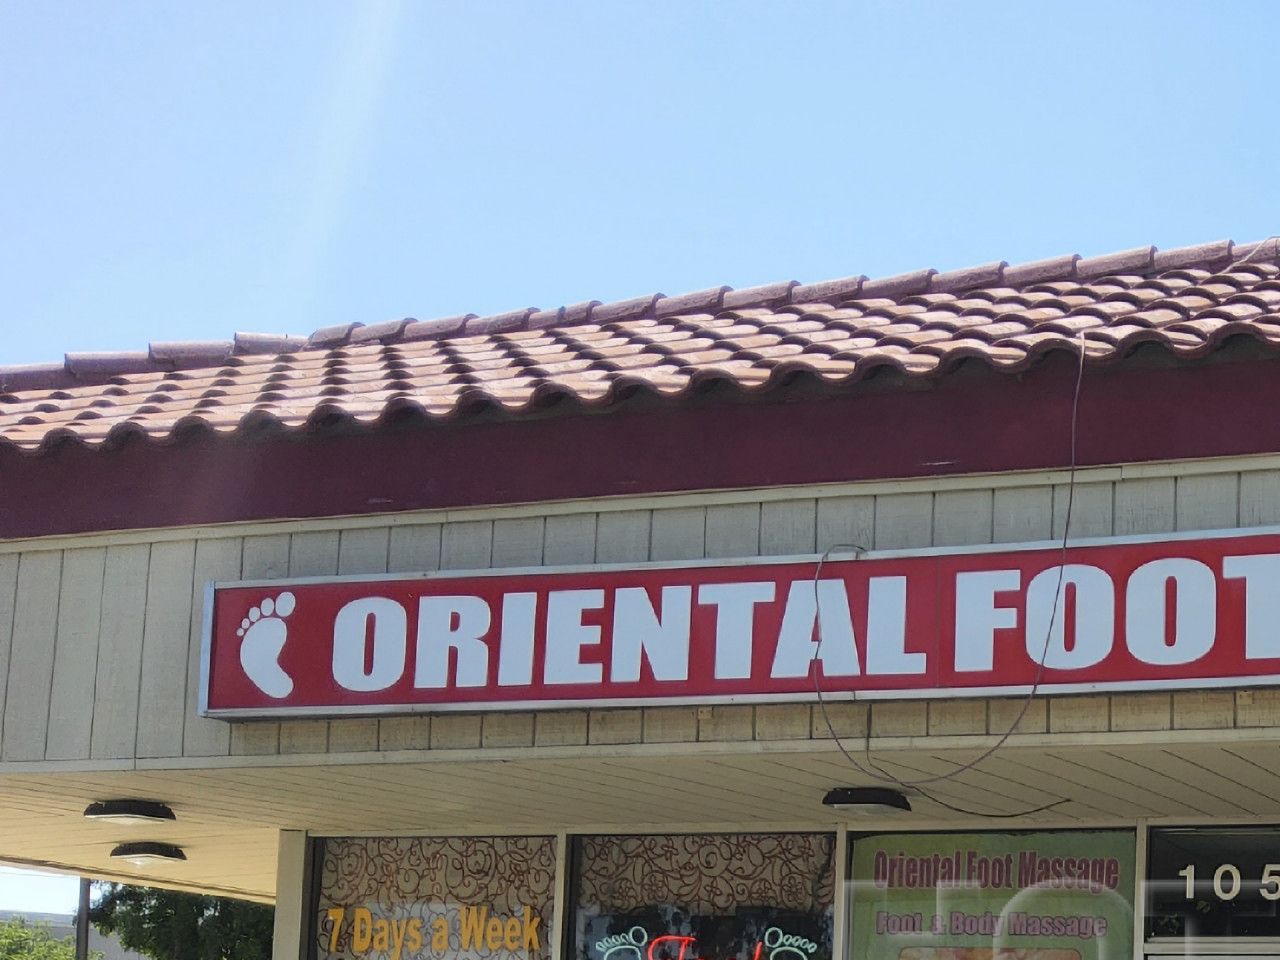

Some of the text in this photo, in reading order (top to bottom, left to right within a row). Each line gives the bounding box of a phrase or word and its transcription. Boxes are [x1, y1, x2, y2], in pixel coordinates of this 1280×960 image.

[332, 576, 927, 692] ORIENTAL
[874, 851, 1120, 894] Oriental Foot Massage
[327, 907, 345, 953] 7
[432, 918, 449, 951] a
[460, 905, 541, 951] Week
[876, 911, 1108, 939] Foot & Body Massage
